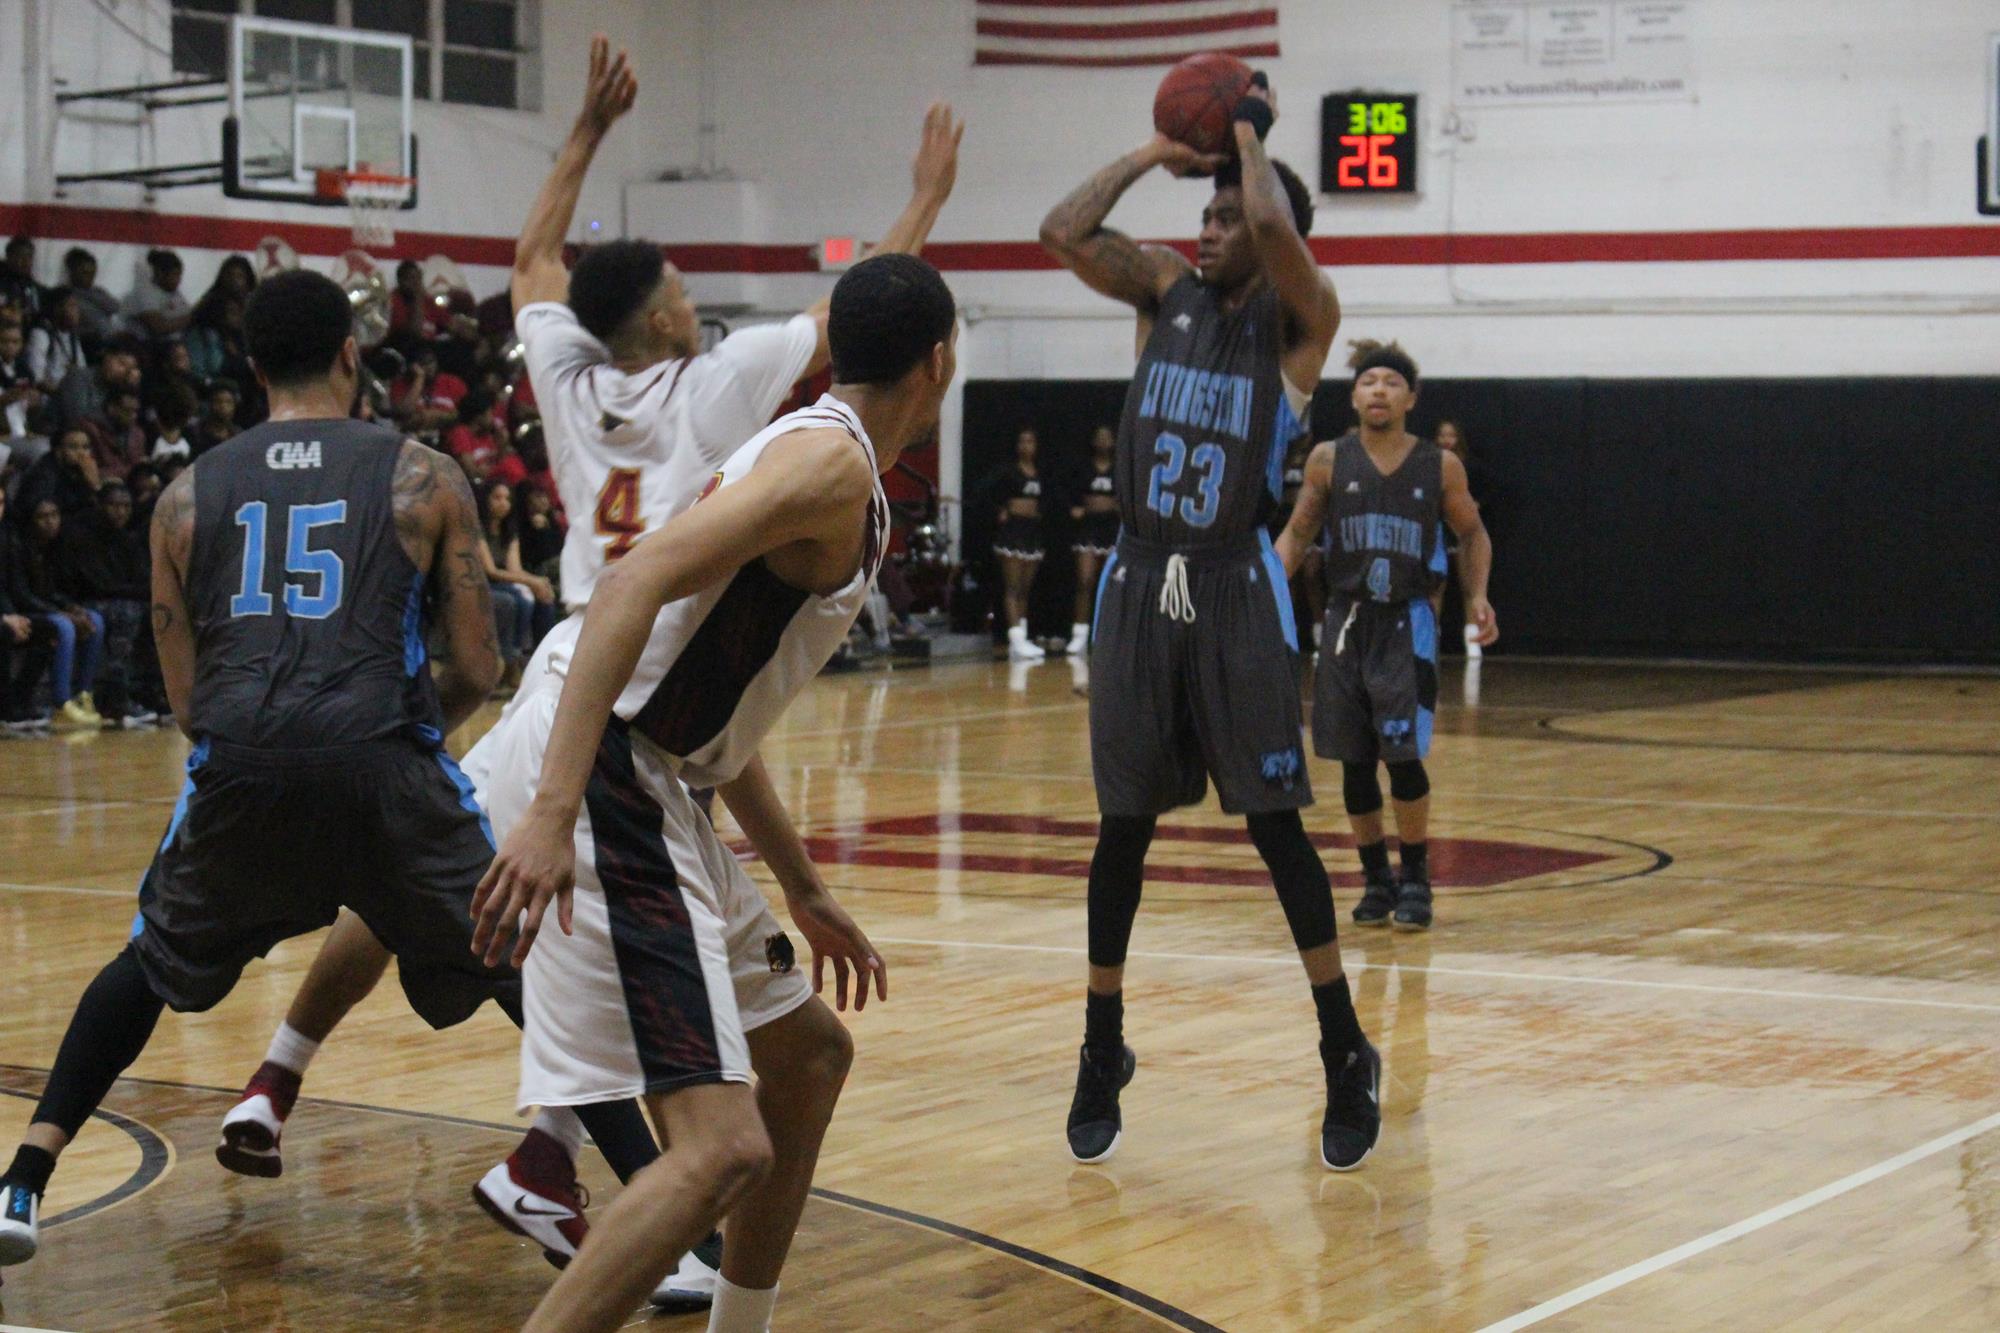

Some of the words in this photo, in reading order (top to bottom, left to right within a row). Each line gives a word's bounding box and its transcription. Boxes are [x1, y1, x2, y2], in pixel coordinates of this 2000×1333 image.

[1337, 134, 1399, 187] 26
[1348, 102, 1407, 135] 3:06
[594, 466, 646, 563] 4
[1147, 431, 1226, 528] 23
[230, 499, 348, 620] 15
